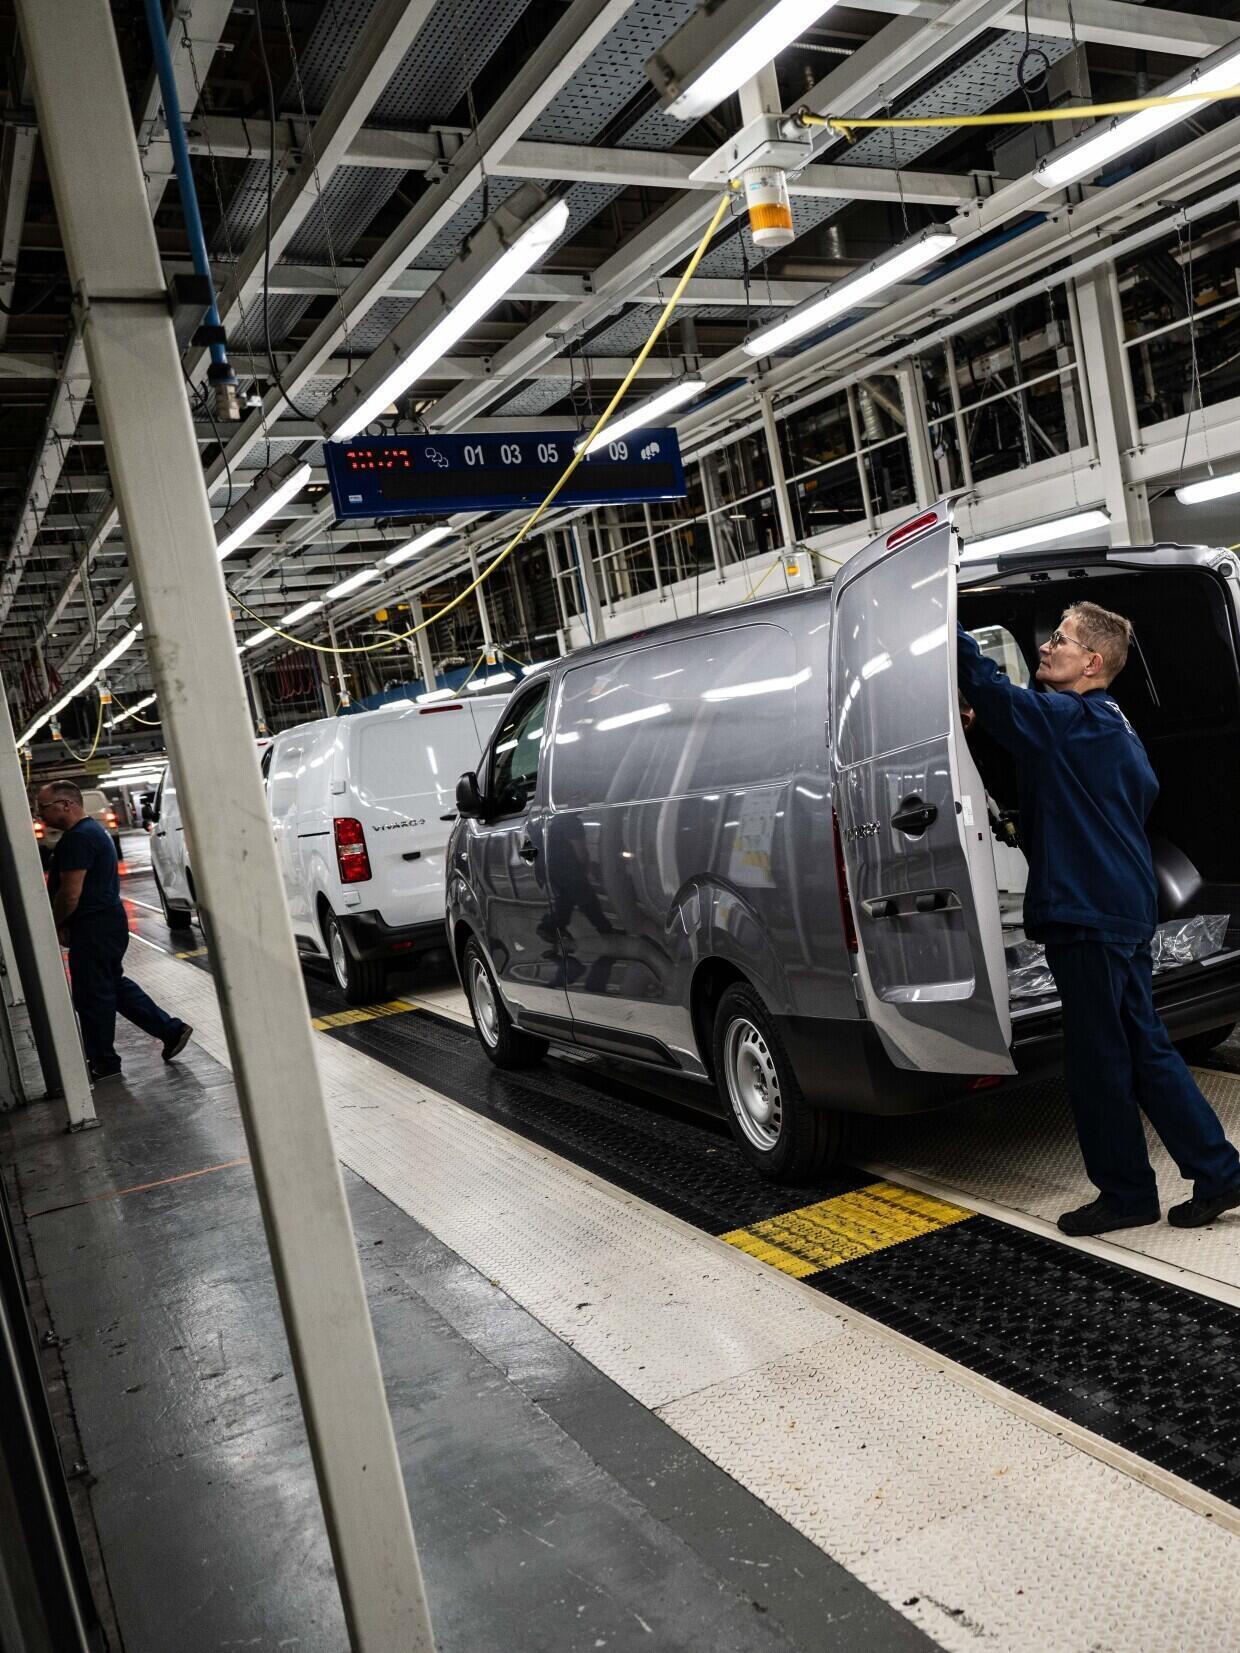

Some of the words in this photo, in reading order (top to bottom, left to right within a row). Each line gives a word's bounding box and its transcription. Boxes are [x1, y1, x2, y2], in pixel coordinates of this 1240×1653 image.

[464, 445, 485, 466] 01
[500, 444, 522, 465] 03
[537, 443, 559, 463] 05
[608, 441, 628, 461] 09
